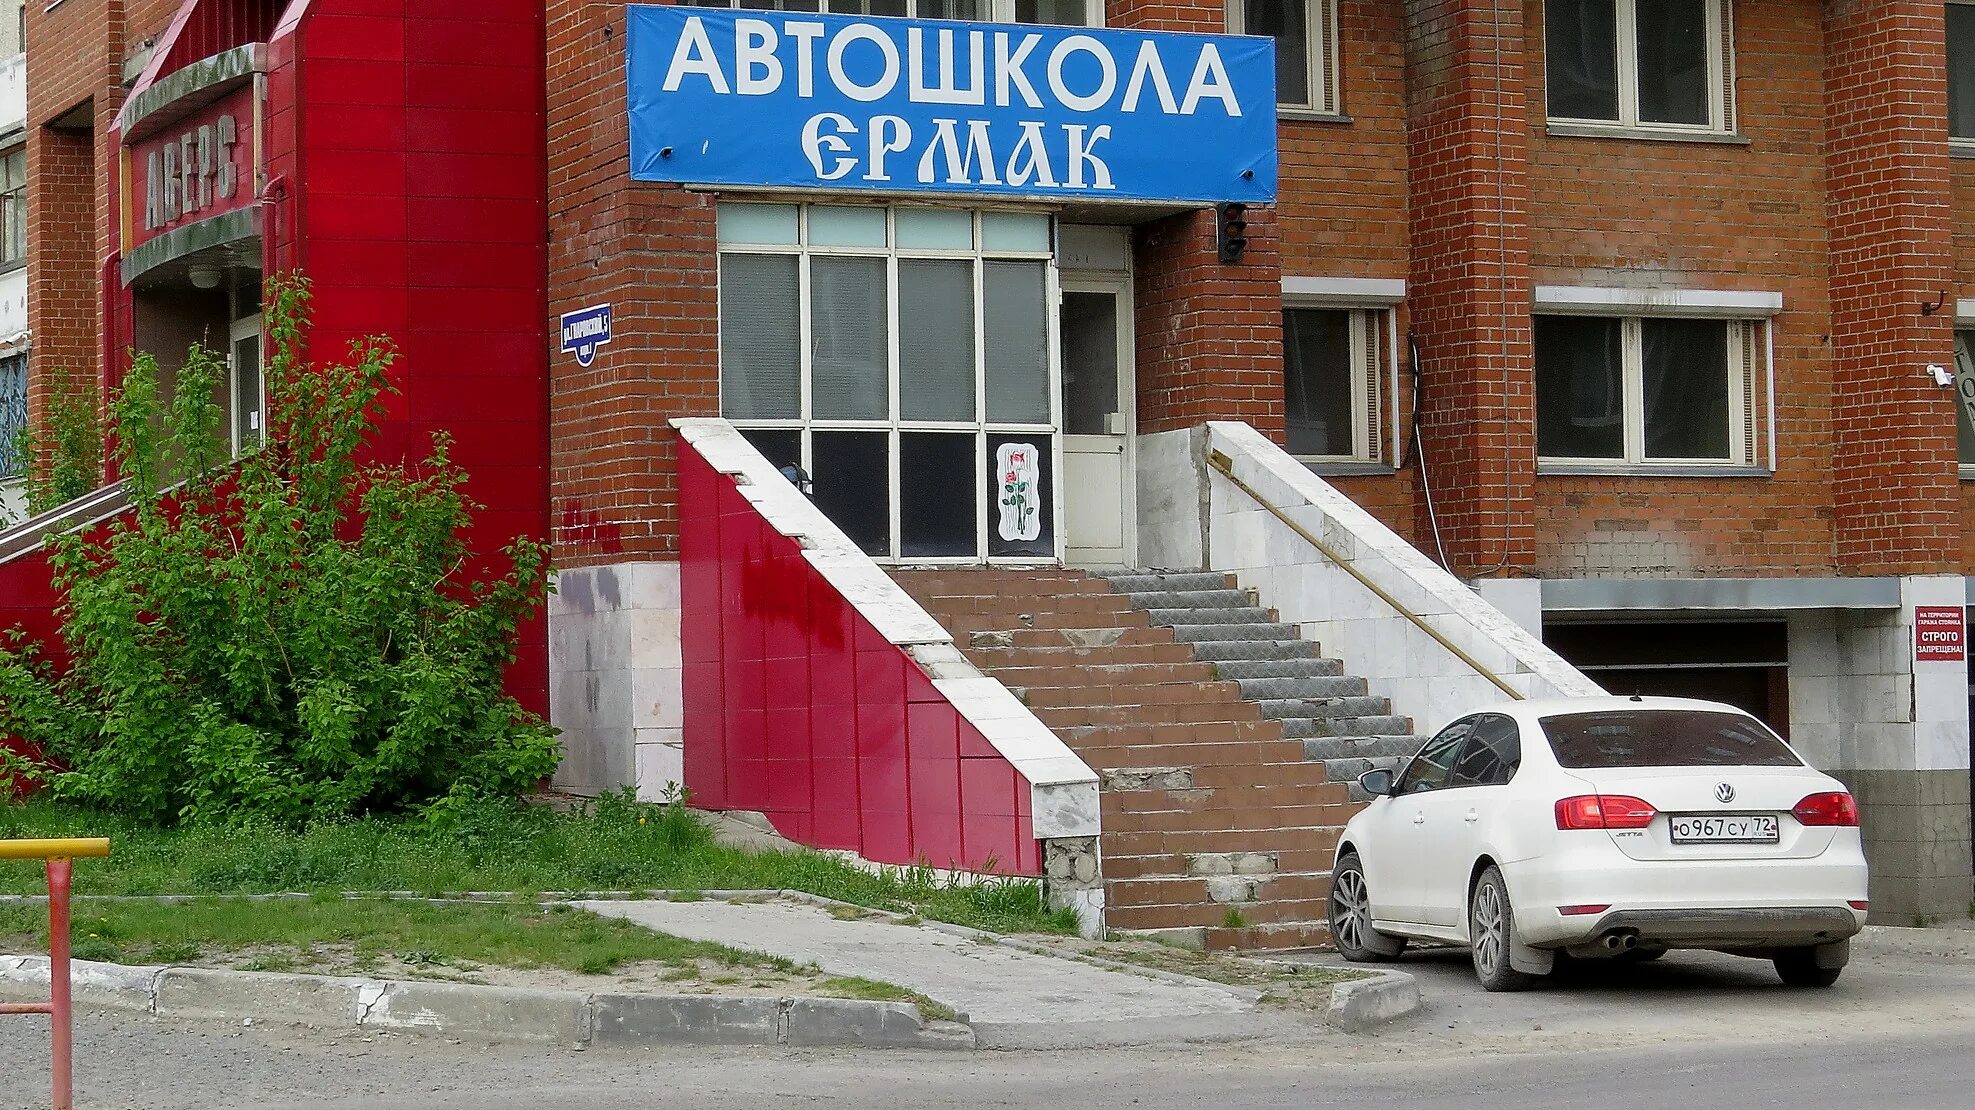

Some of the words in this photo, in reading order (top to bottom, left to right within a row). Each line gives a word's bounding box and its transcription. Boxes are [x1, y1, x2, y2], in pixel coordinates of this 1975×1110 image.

[661, 15, 1243, 117] АВТОШКОЛА
[145, 114, 238, 231] АВЕРС
[1921, 631, 1958, 642] СТРОГО
[1917, 645, 1963, 653] ЗАПРЕЩЕНА!
[1752, 817, 1771, 832] 72
